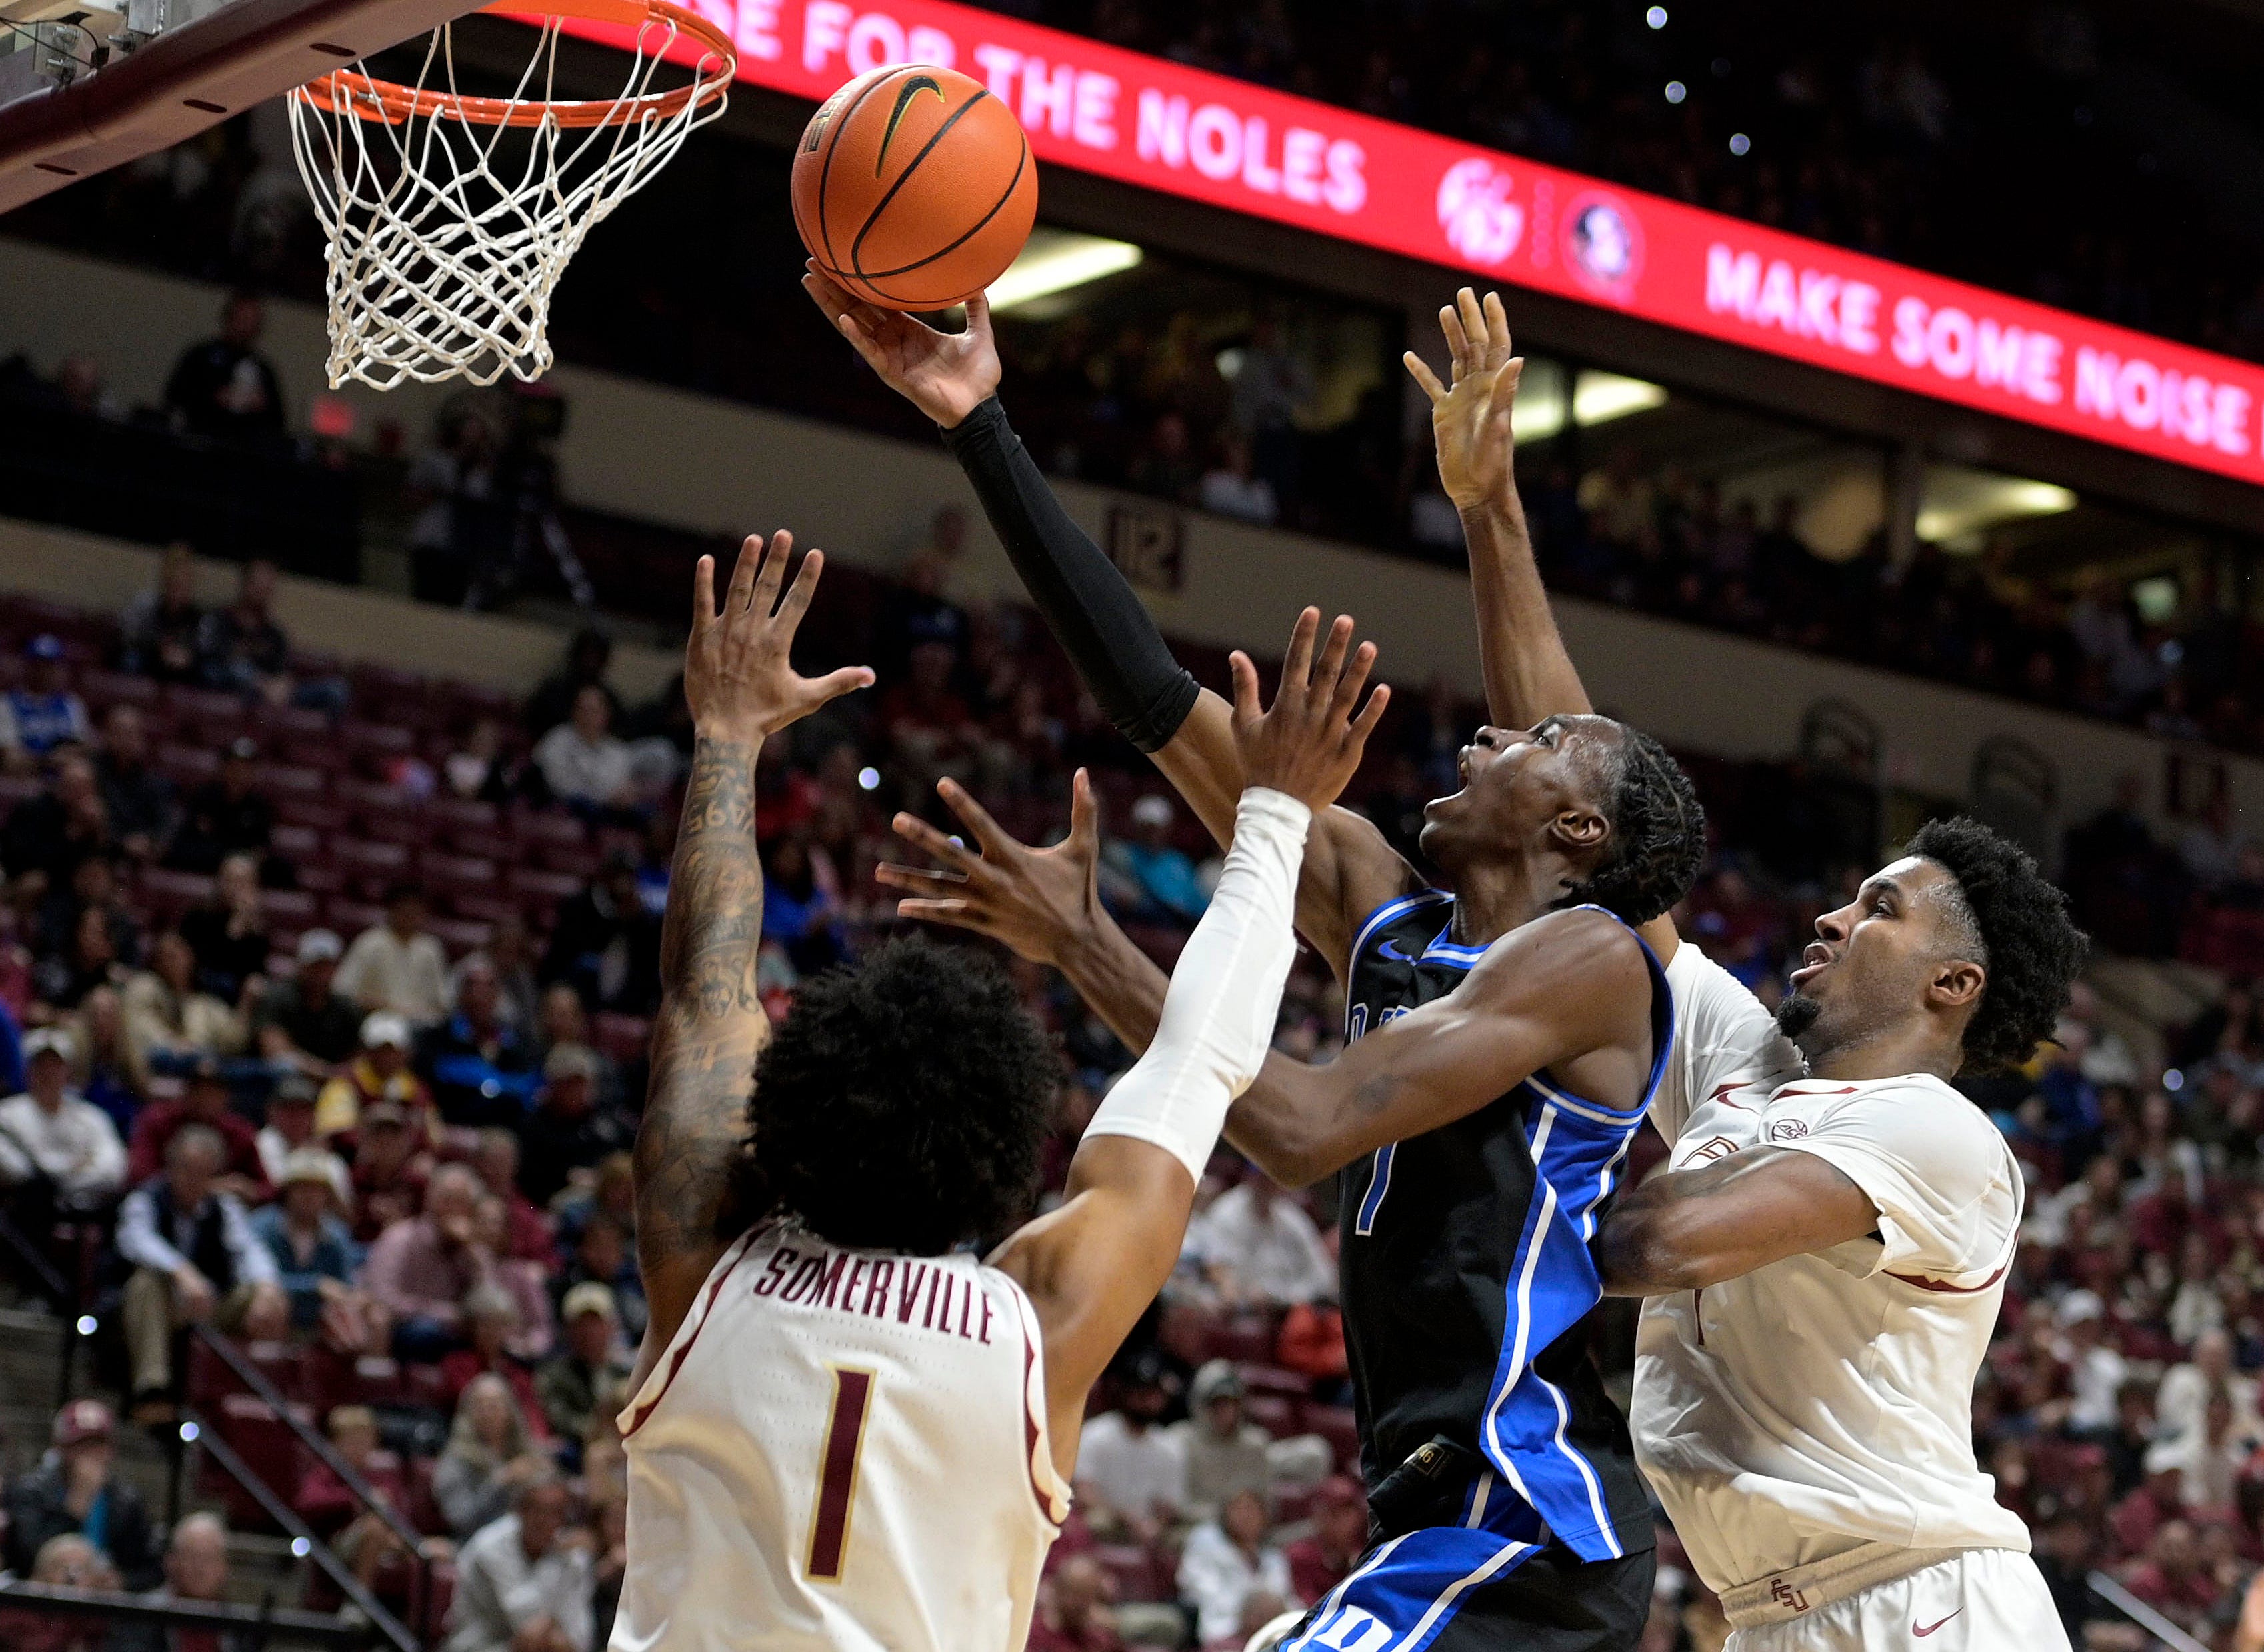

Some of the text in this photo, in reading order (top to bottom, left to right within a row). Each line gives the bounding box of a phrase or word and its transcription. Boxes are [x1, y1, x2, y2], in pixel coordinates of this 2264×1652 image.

[974, 43, 1119, 151] THE
[1135, 87, 1367, 215] NOLES
[1705, 243, 1881, 354] MAKE
[1893, 297, 2063, 404] SOME
[2075, 345, 2251, 456] NOISE
[753, 1248, 994, 1345] SOMERVILLE
[803, 1361, 877, 1585] 1
[1771, 1579, 1809, 1613] FSU
